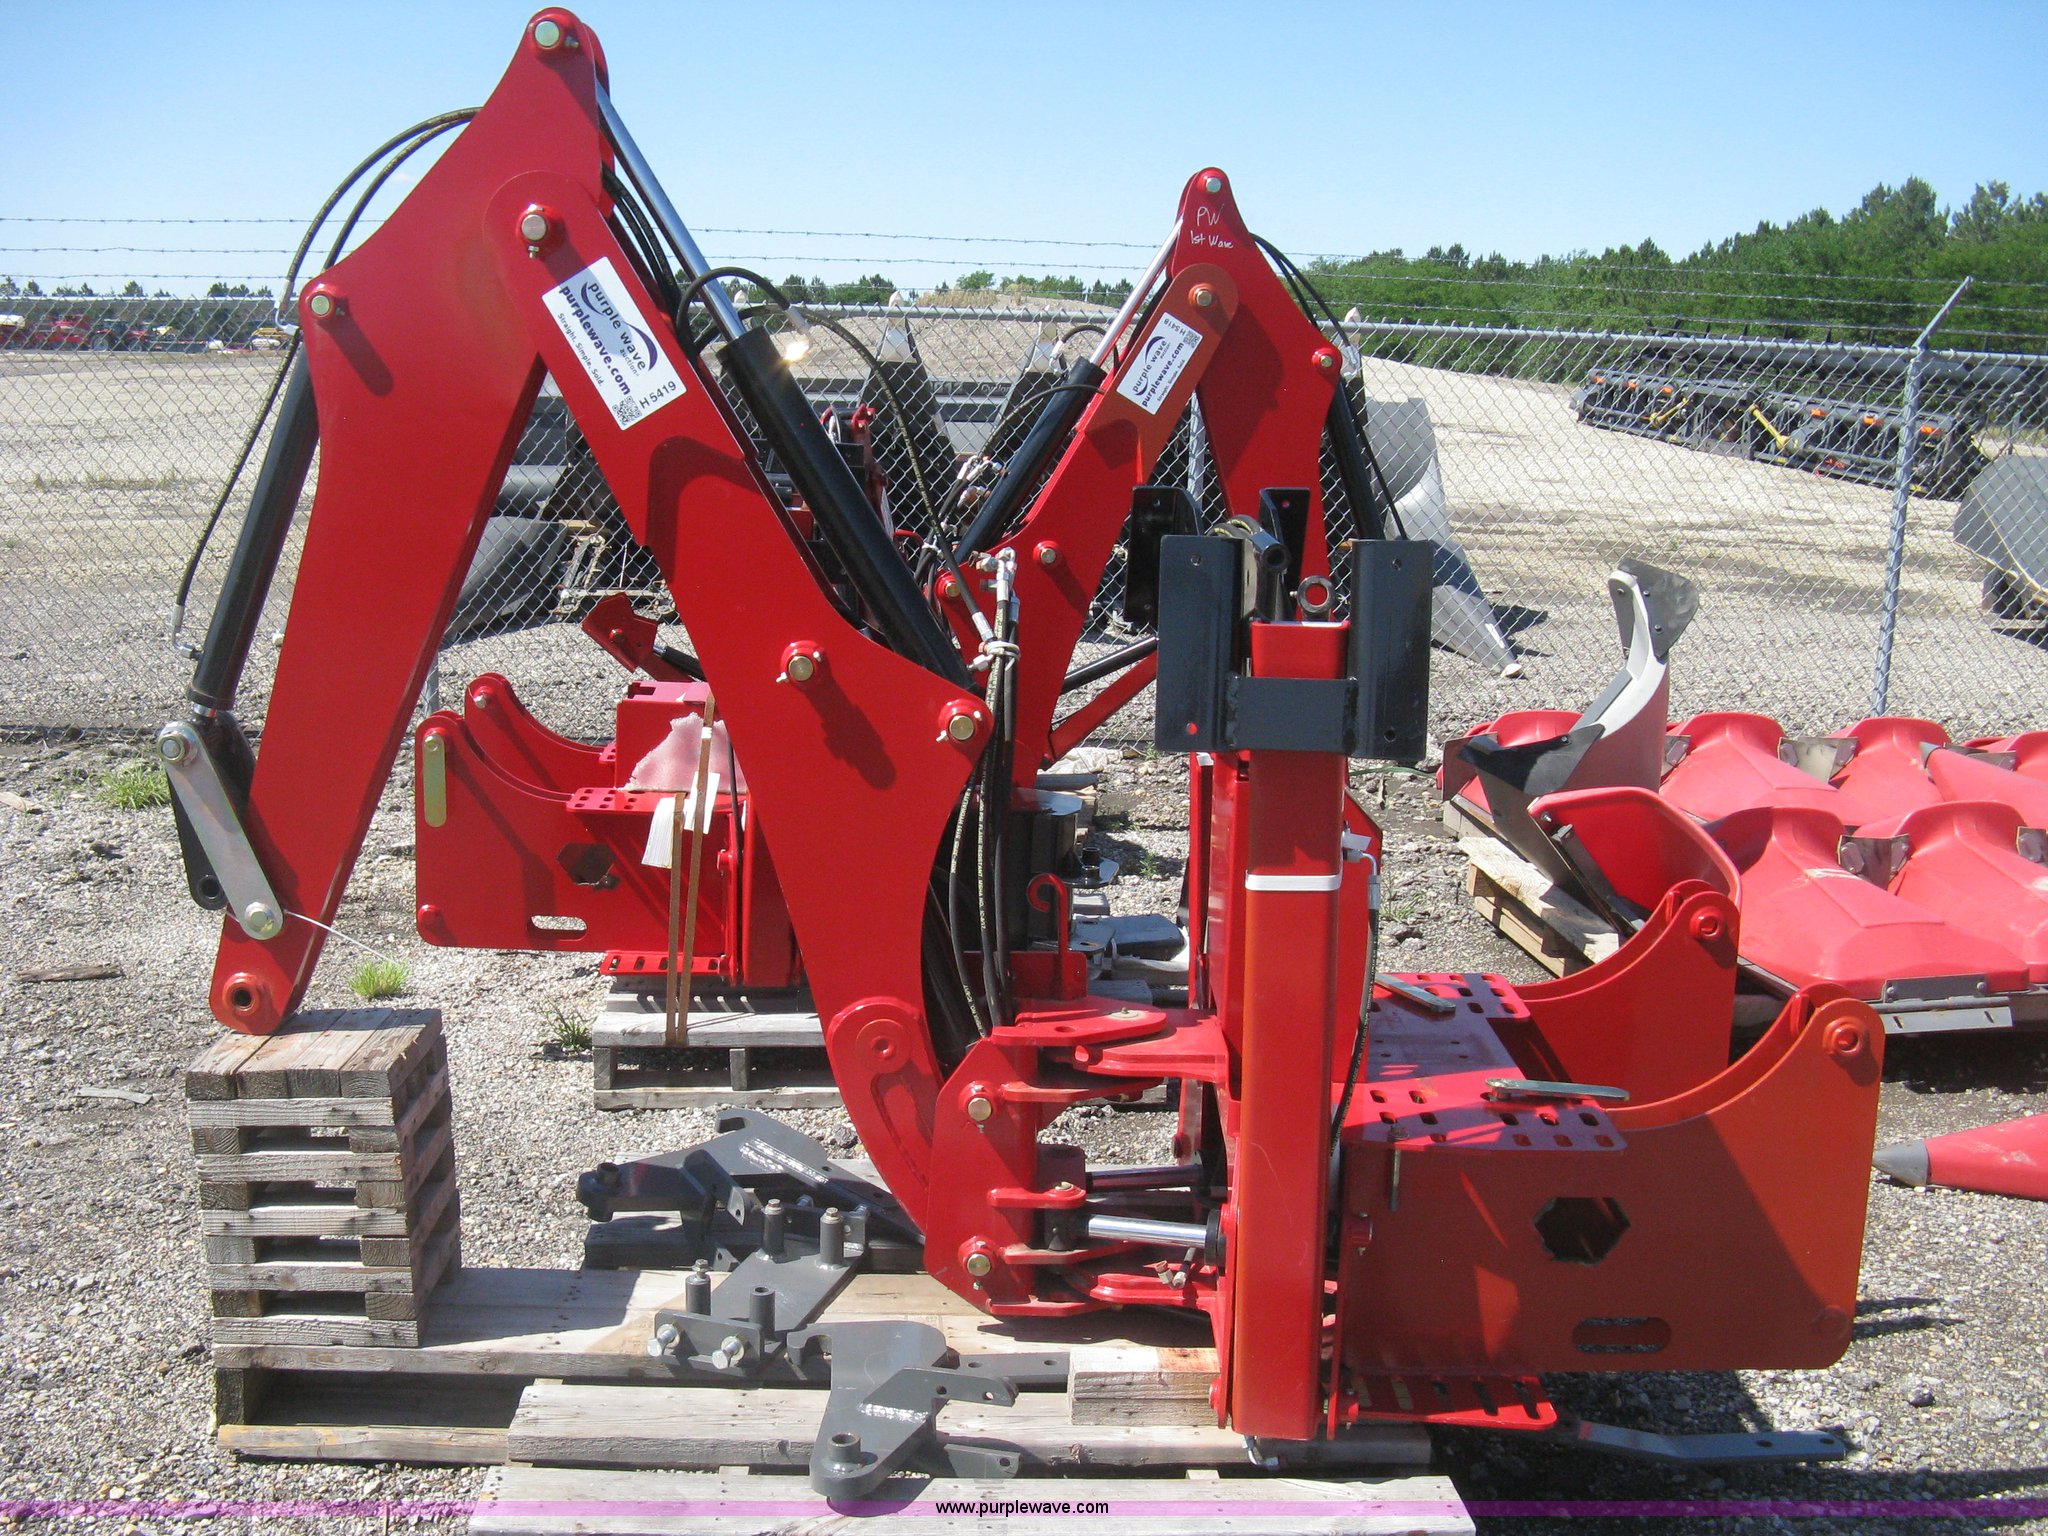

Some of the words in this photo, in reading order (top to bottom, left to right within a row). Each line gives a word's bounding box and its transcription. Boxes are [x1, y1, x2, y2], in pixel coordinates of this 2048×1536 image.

[1209, 234, 1234, 249] Wave
[557, 313, 576, 343] Straight.
[575, 342, 592, 369] Simple.
[592, 368, 605, 386] Sold.
[559, 286, 631, 395] purplewave.com
[588, 282, 622, 330] purple
[620, 332, 646, 371] wave
[619, 348, 638, 376] auction
[1132, 364, 1152, 392] purple
[1150, 340, 1167, 363] wave
[1141, 342, 1185, 407] purplewave.com
[639, 398, 650, 409] H
[650, 380, 677, 403] 5419
